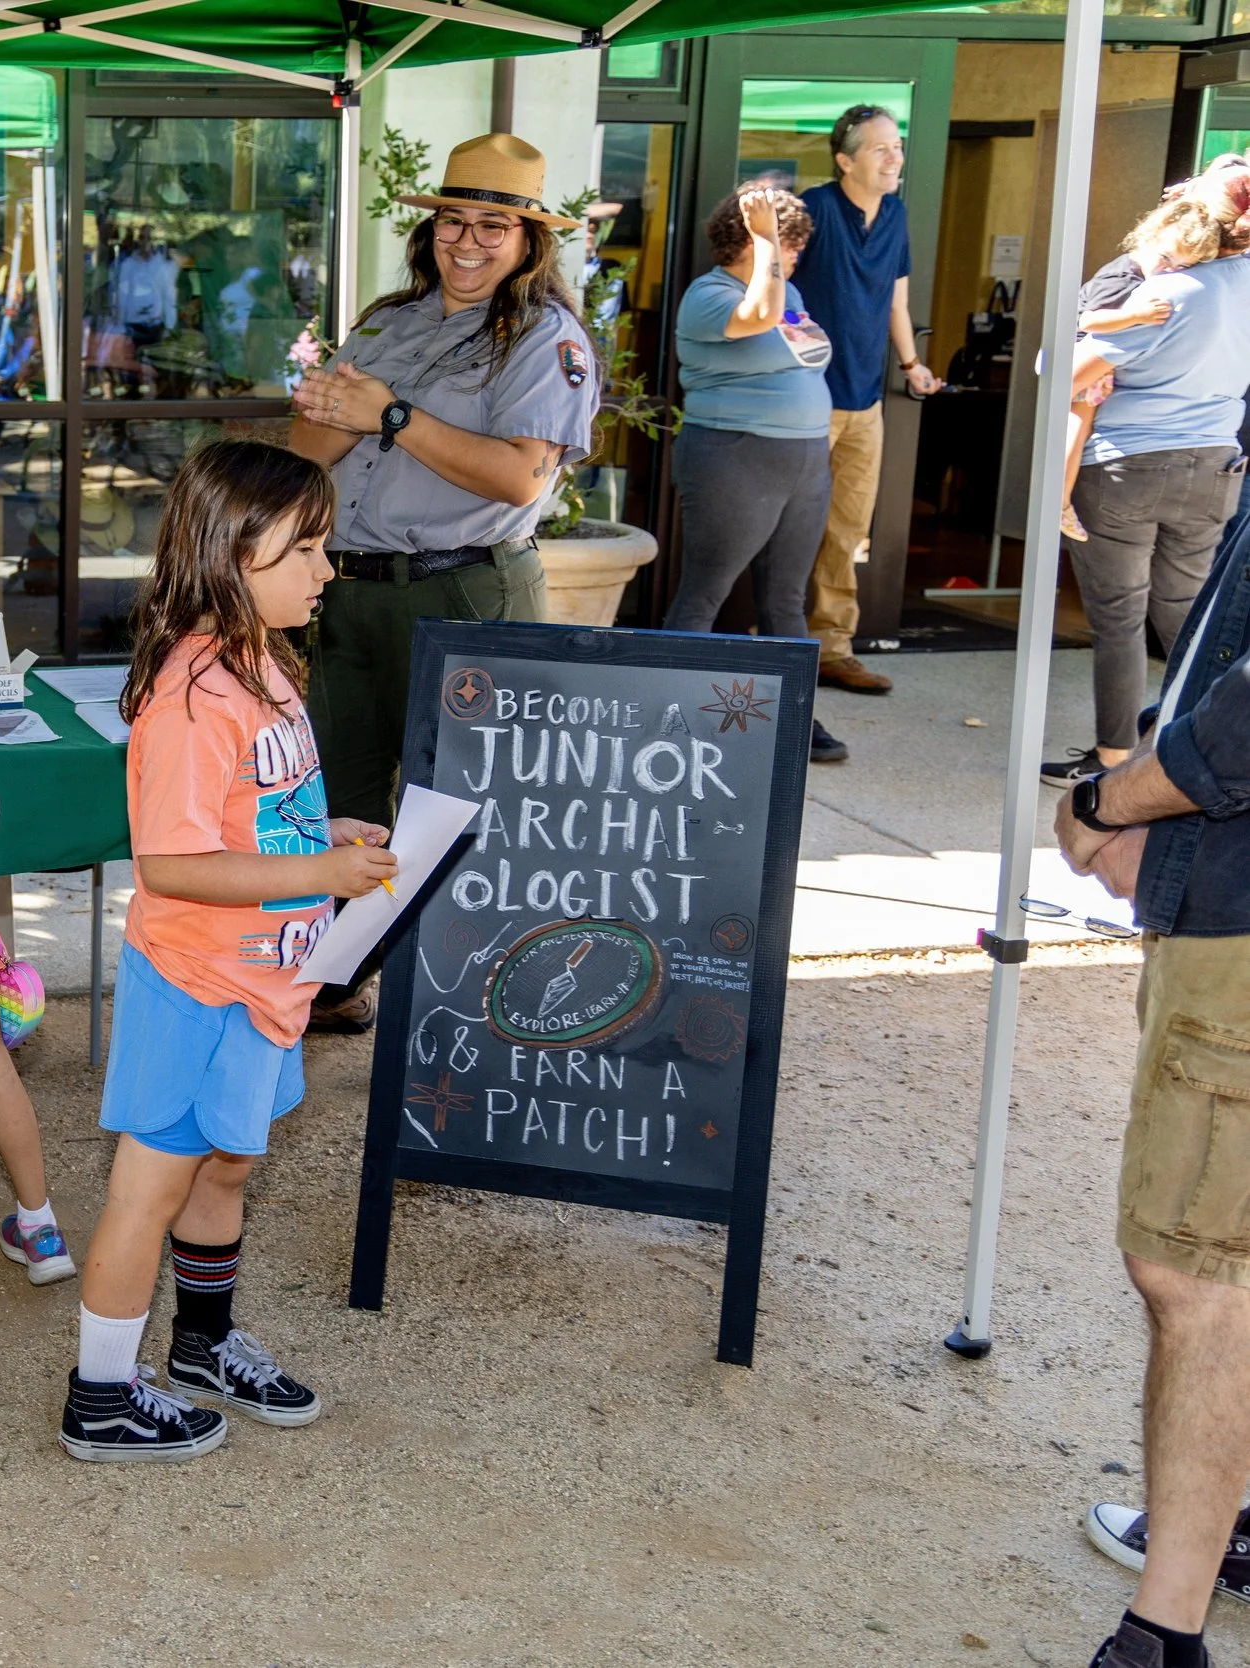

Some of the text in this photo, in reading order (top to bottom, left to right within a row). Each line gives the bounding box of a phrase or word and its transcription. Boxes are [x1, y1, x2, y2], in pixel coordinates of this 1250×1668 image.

[494, 688, 691, 737] BECOME A
[462, 723, 738, 801] JUNIOR
[451, 857, 711, 925] OLOGIST
[672, 952, 748, 969] IRON OR SEW ON
[682, 963, 704, 973] YOUR
[510, 1011, 584, 1033] EXPLORE
[585, 993, 619, 1019] LEARN
[510, 1045, 625, 1090] EARN
[662, 1061, 687, 1100] A
[484, 1088, 678, 1167] PATCH!
